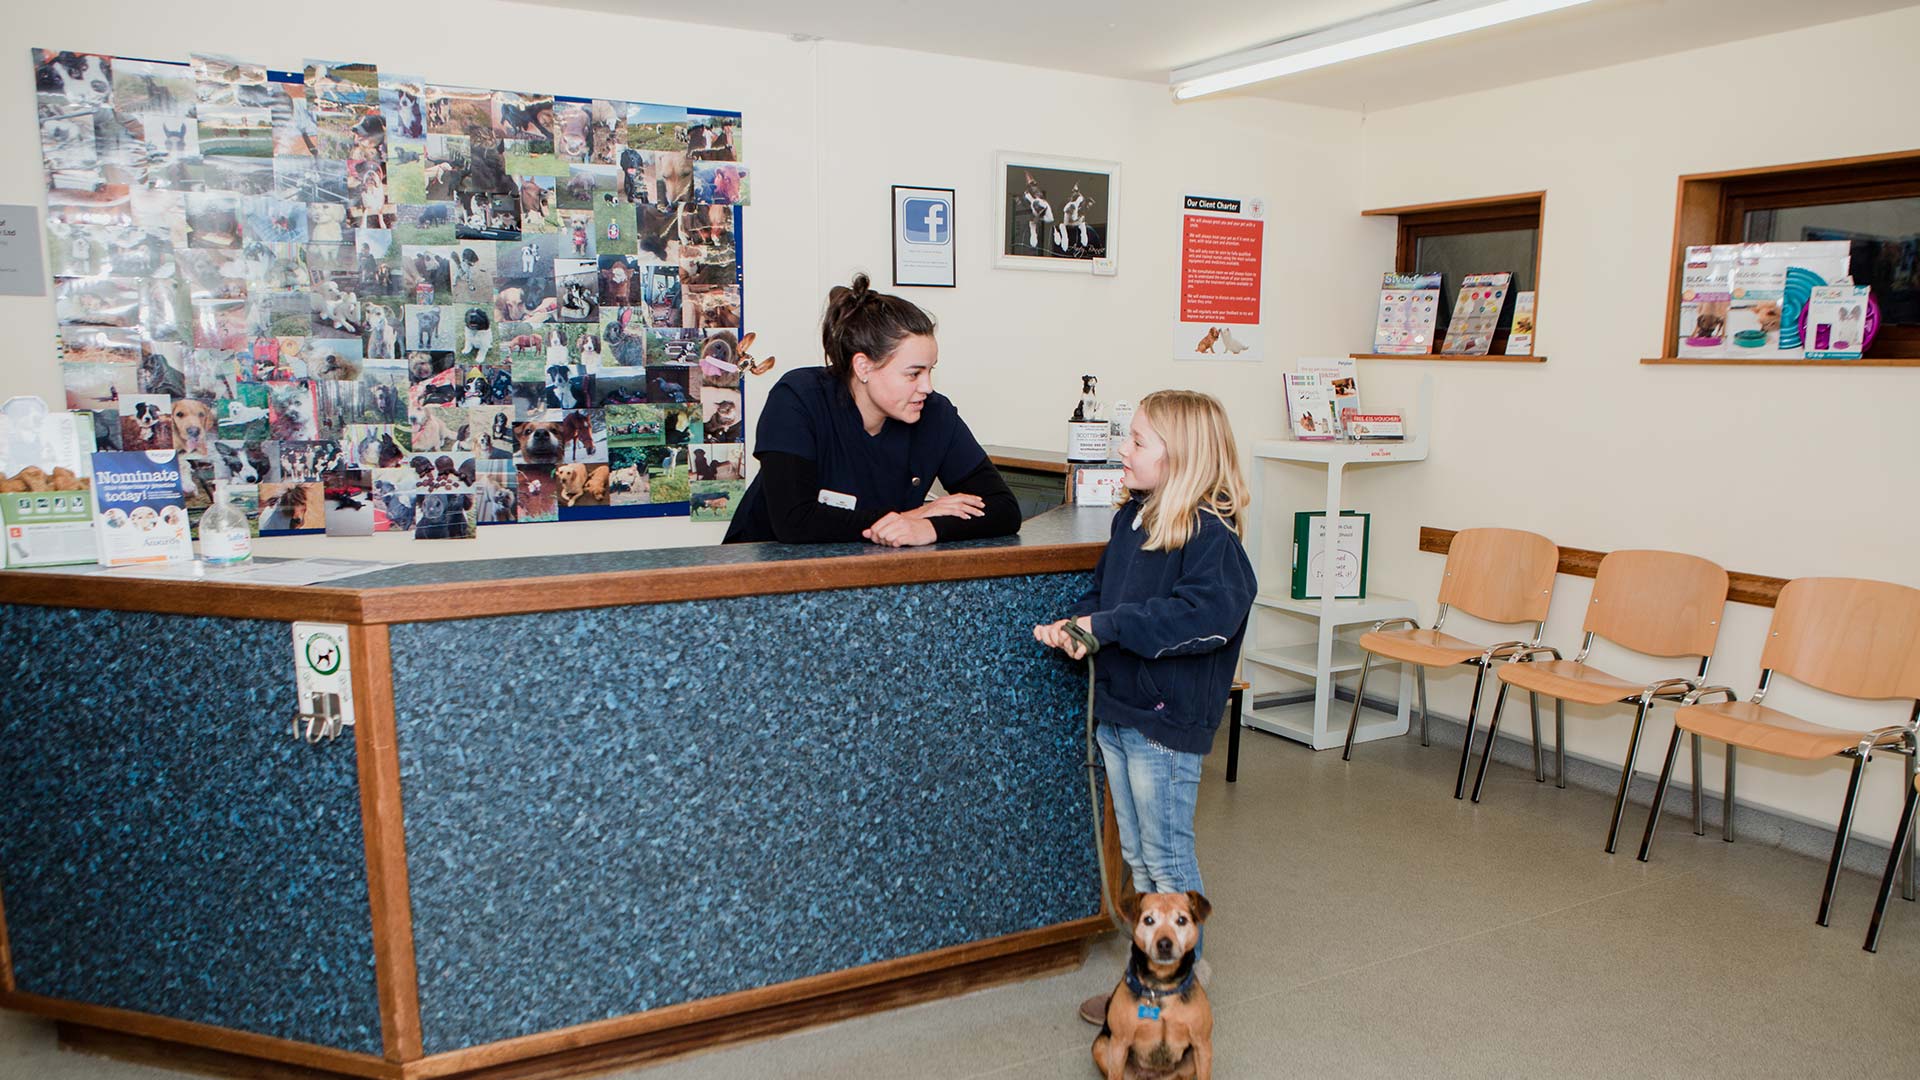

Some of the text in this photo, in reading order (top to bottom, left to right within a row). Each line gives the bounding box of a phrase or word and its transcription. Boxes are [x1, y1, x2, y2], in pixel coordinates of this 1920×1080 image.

[1187, 199, 1238, 210] Our Client Charter
[96, 470, 179, 484] Nominate
[105, 490, 147, 502] today!
